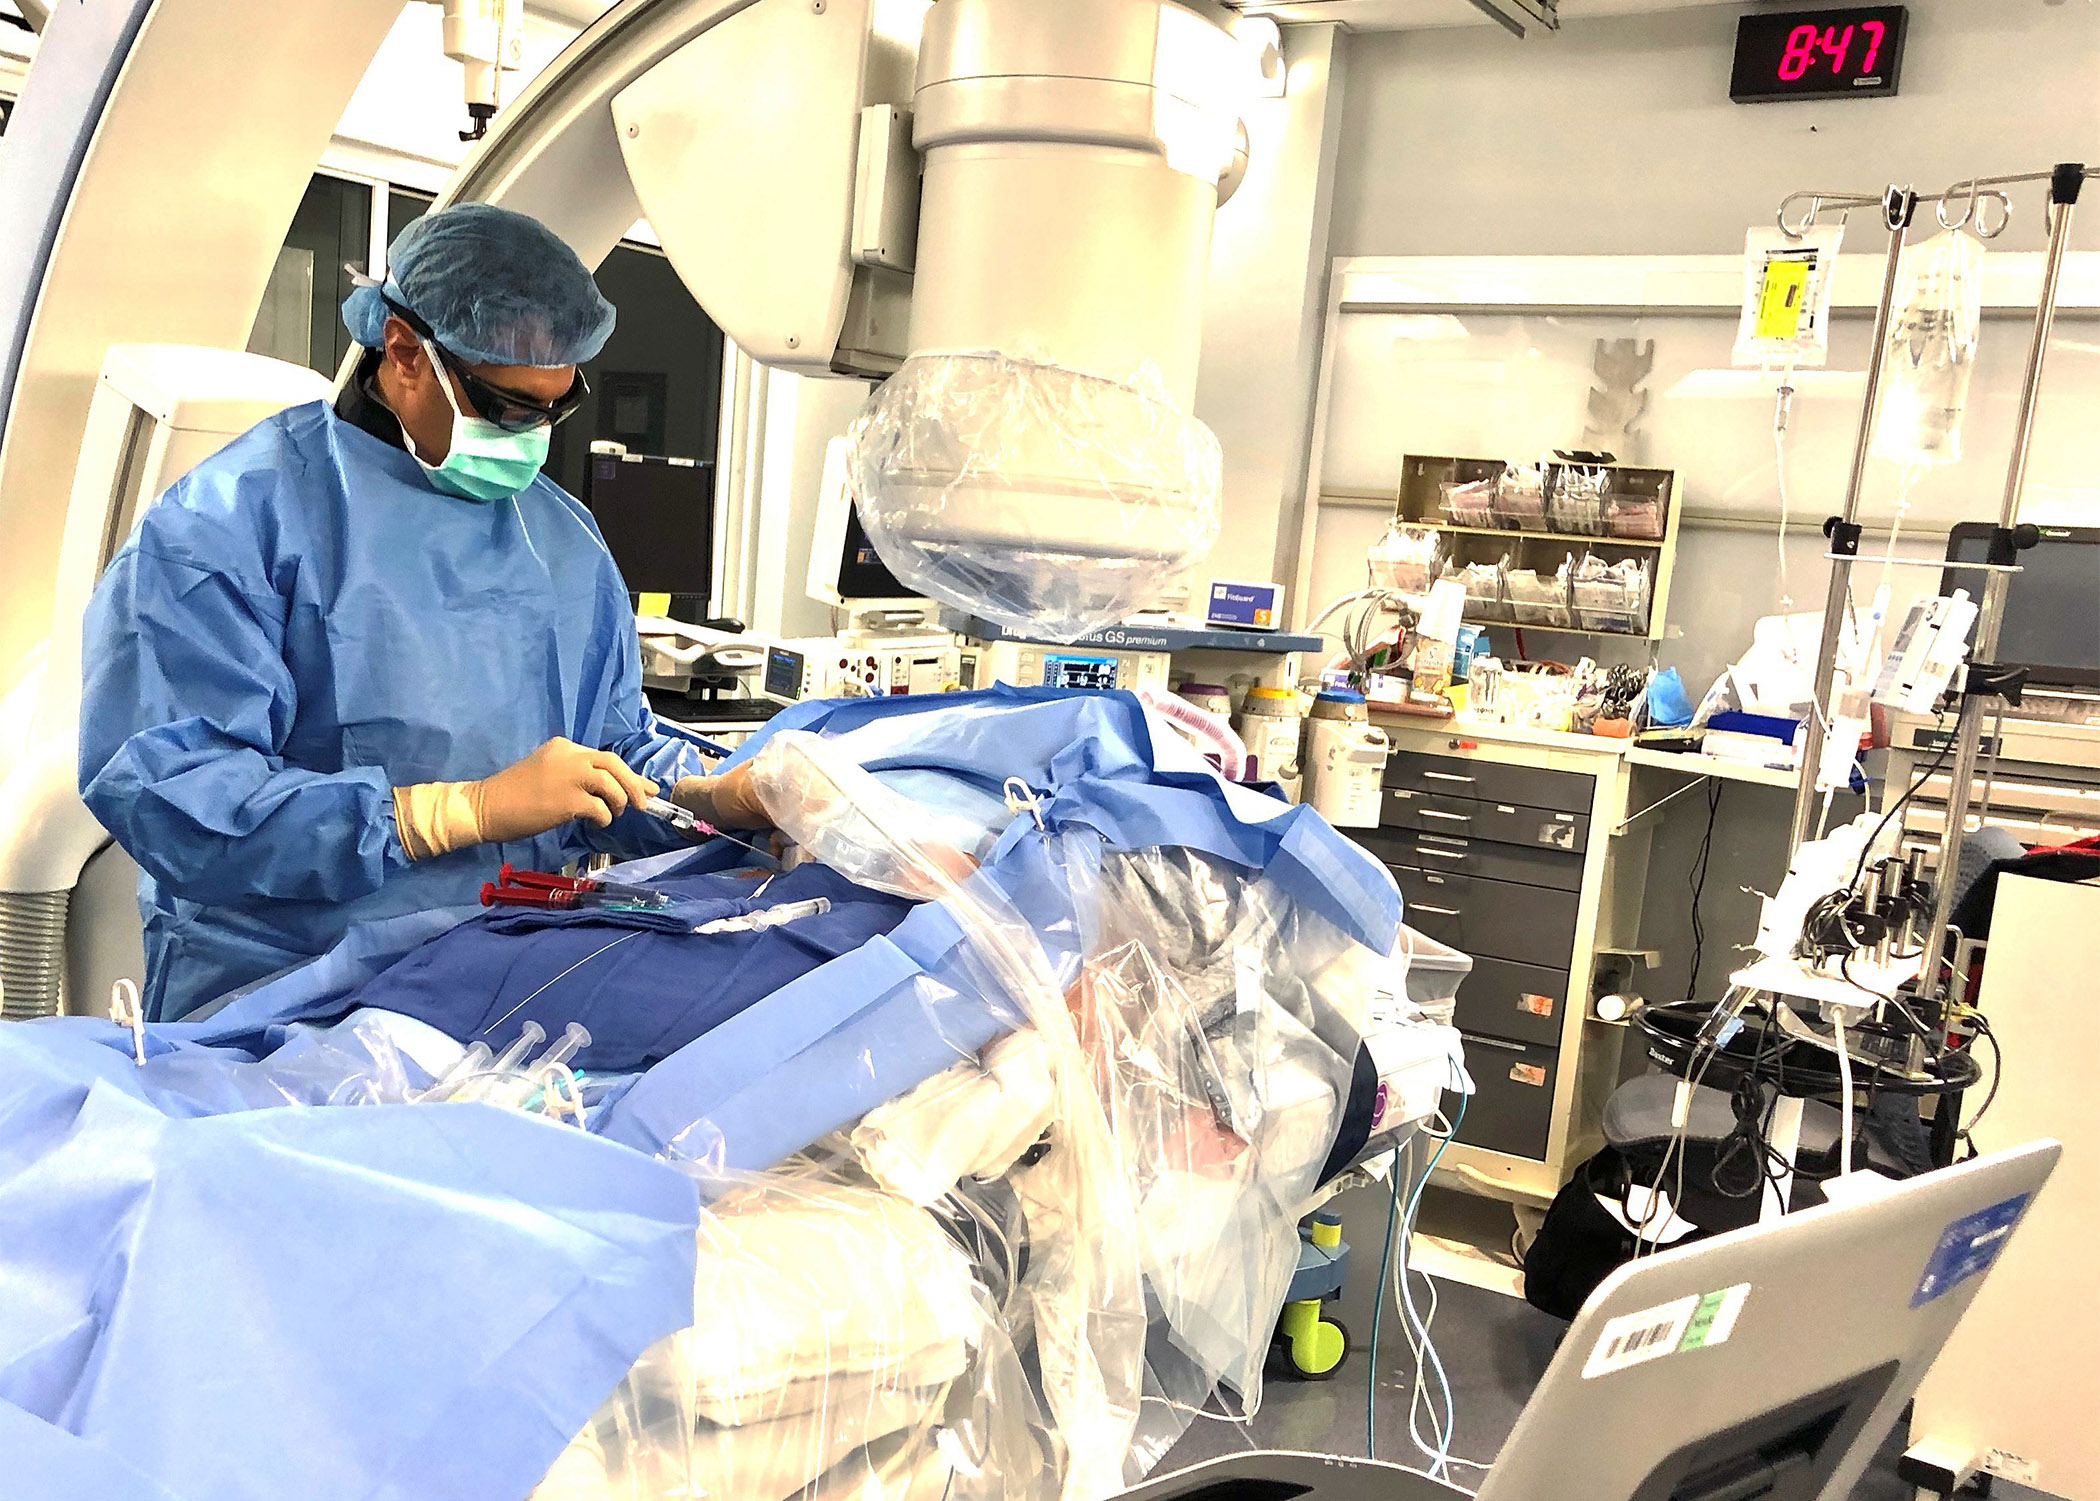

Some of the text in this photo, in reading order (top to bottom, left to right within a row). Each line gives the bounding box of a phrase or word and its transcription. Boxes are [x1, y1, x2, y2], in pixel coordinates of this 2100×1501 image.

[1778, 21, 1885, 81] 8:47
[1258, 608, 1267, 622] S
[1105, 630, 1125, 644] GS
[1125, 637, 1167, 646] premium
